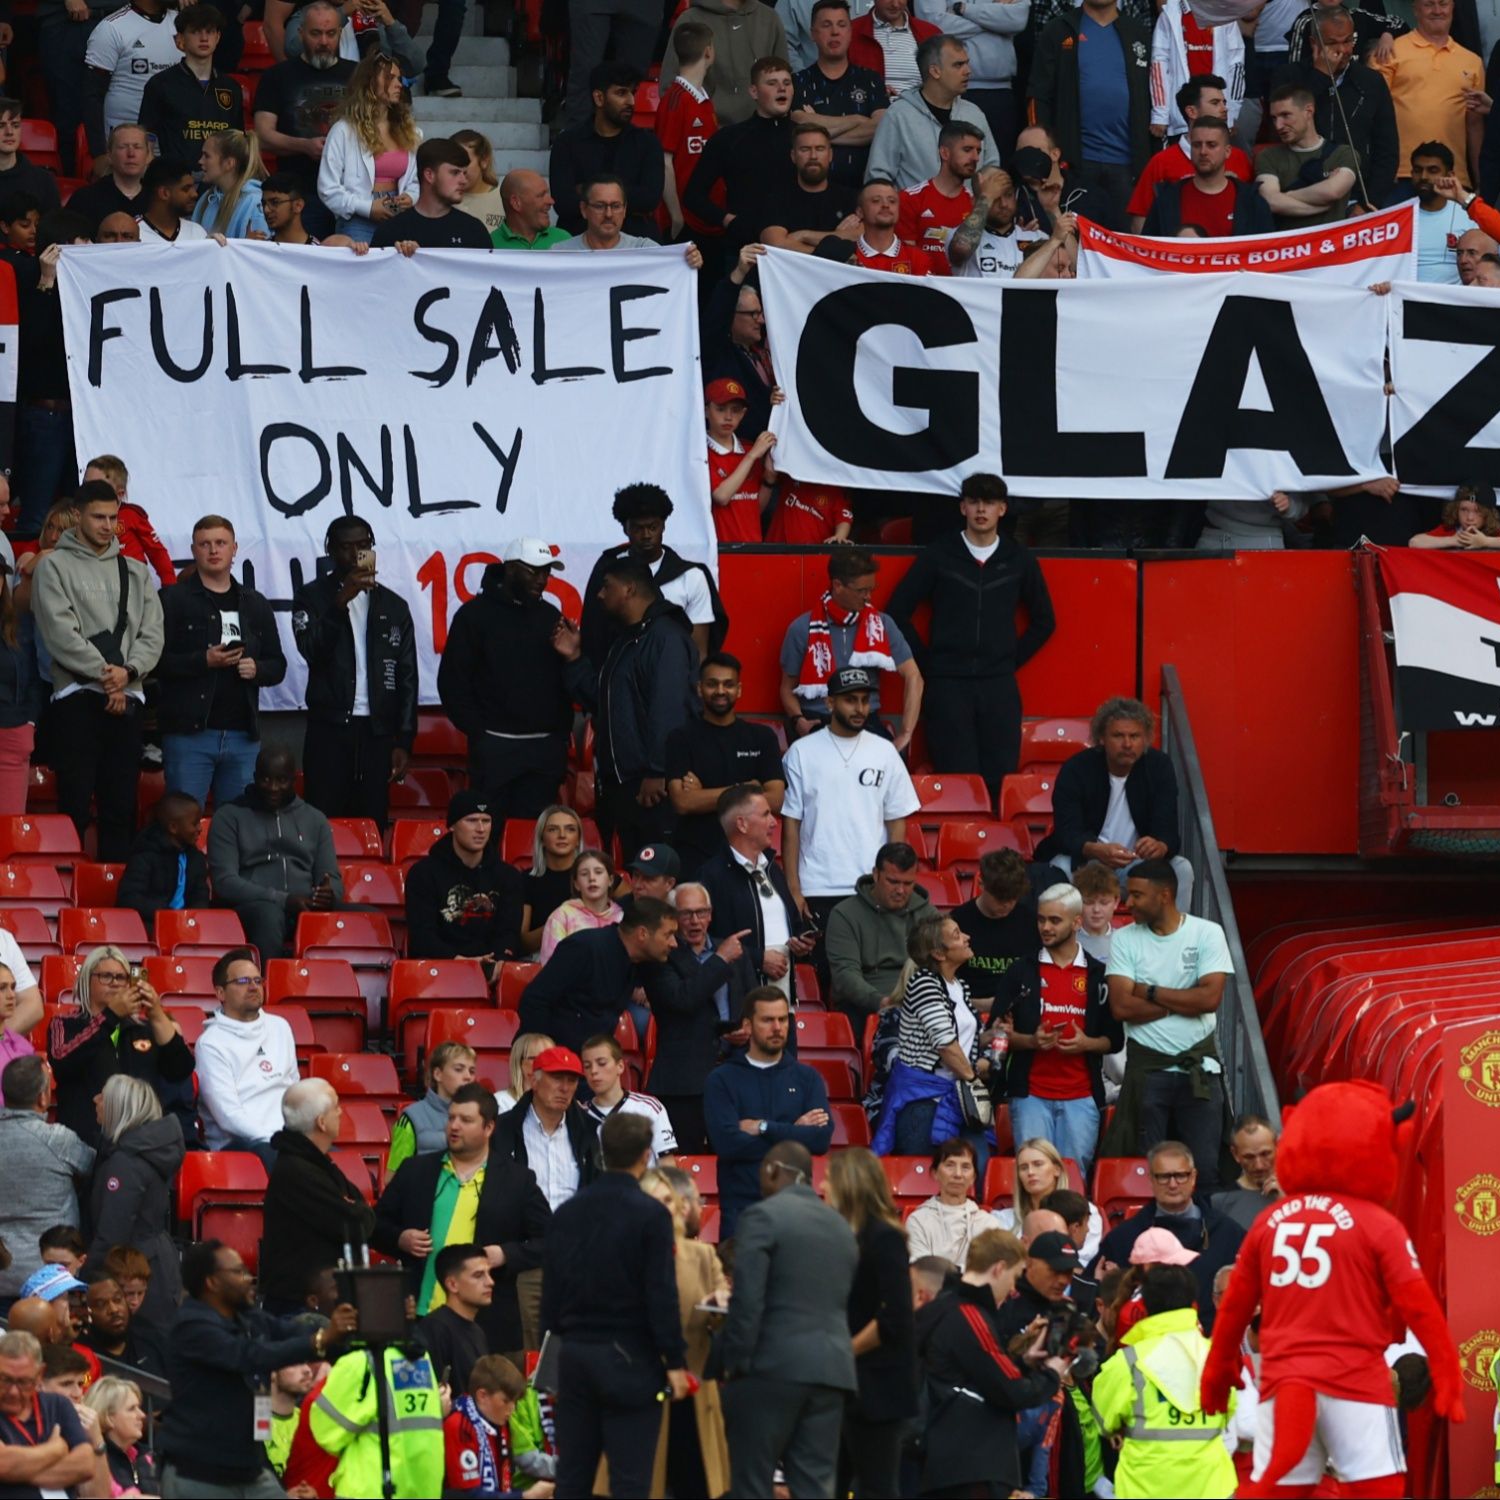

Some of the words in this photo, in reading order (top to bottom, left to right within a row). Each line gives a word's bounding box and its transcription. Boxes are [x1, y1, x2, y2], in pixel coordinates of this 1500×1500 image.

[187, 120, 229, 130] SHARP
[1247, 243, 1312, 265] BORN
[1319, 239, 1336, 254] &
[1343, 222, 1400, 250] BRED
[87, 282, 368, 388] FULL
[407, 284, 674, 388] SALE
[259, 421, 523, 518] ONLY
[1266, 1199, 1302, 1229] FRED
[1304, 1194, 1332, 1212] THE
[1328, 1202, 1355, 1231] RED
[1269, 1221, 1337, 1289] 55
[404, 1393, 429, 1414] 37
